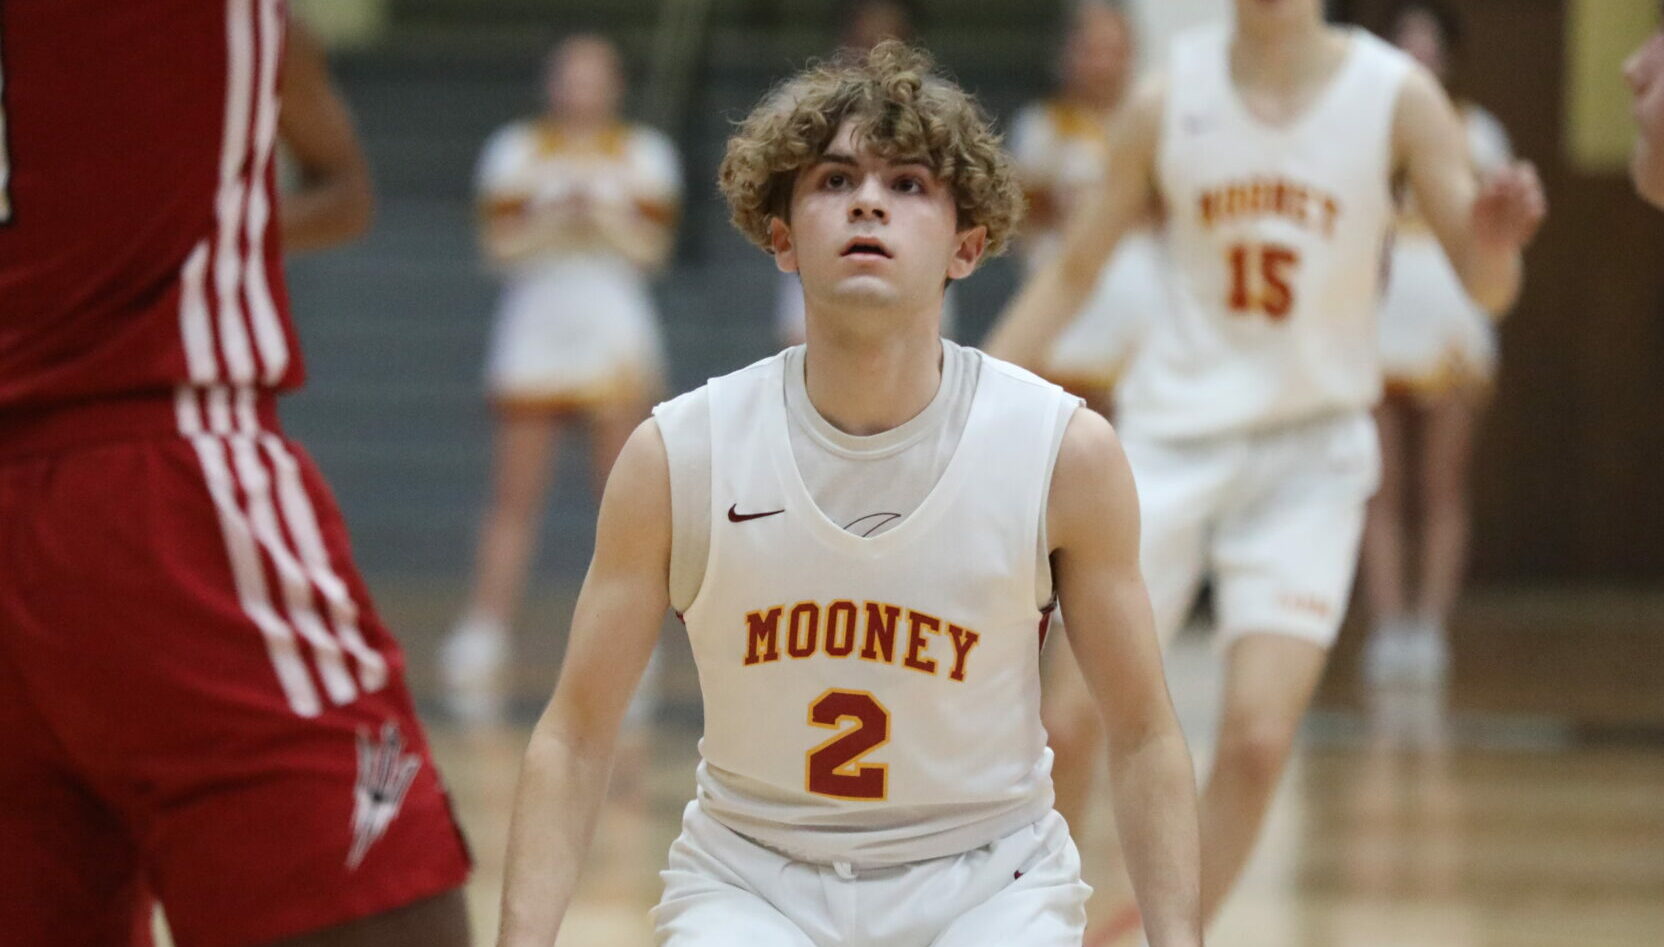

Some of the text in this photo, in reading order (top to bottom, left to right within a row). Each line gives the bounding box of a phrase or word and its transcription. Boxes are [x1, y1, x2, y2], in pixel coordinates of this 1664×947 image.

[1225, 244, 1299, 320] 15
[743, 600, 980, 682] MOONEY
[805, 688, 891, 801] 2
